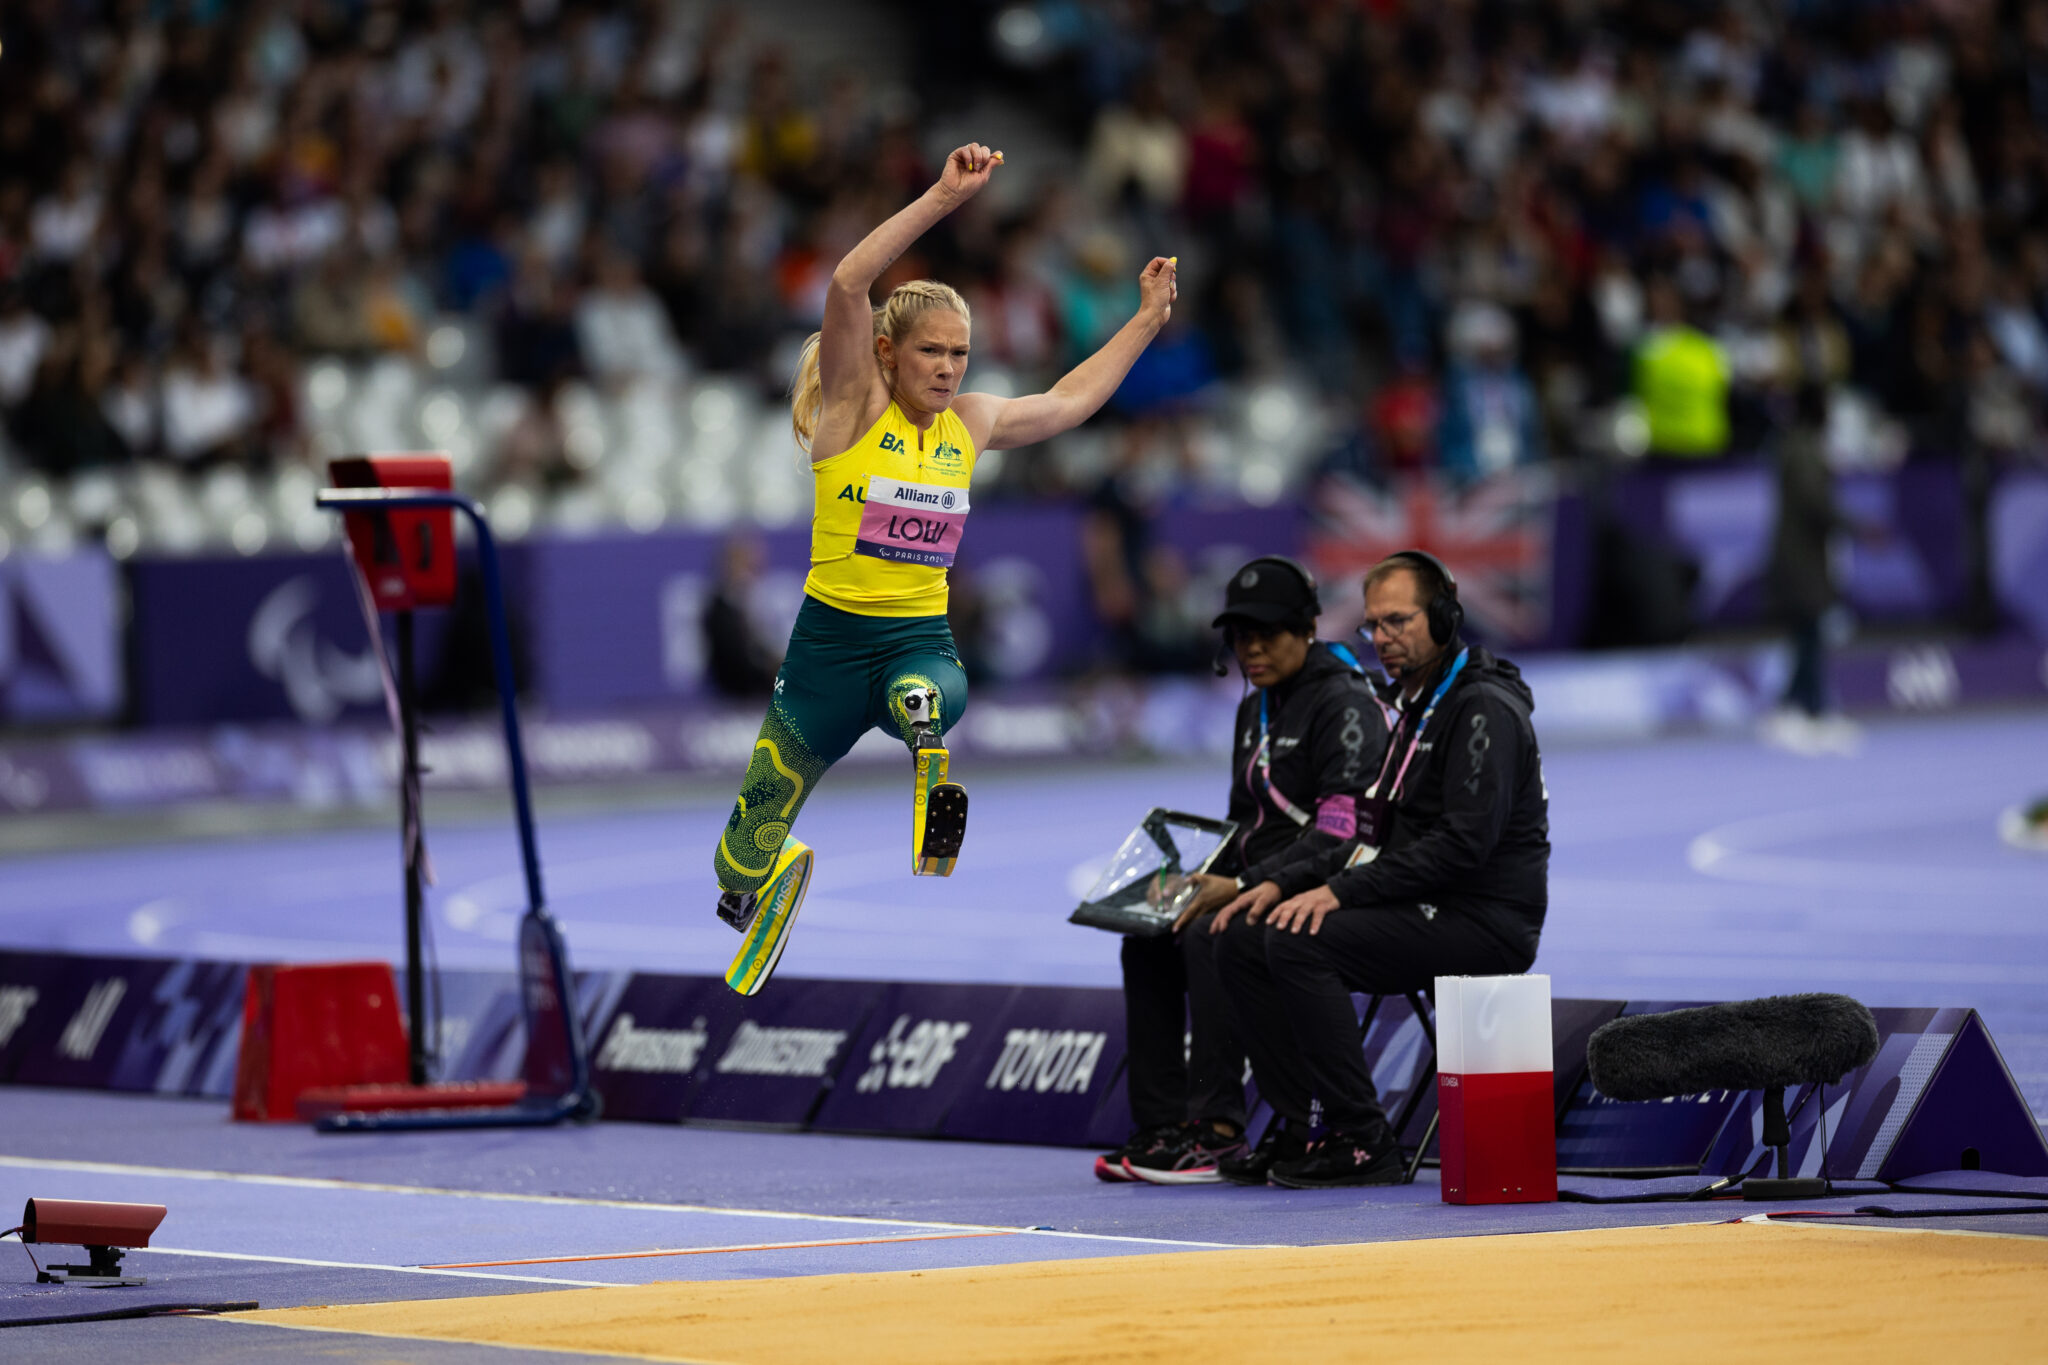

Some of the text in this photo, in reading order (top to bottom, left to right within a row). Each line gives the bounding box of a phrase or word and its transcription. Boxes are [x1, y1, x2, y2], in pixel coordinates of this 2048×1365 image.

[894, 487, 939, 505] Allianz
[888, 515, 948, 544] LOW
[895, 551, 921, 561] PARIS
[985, 1027, 1107, 1094] TOYOTA
